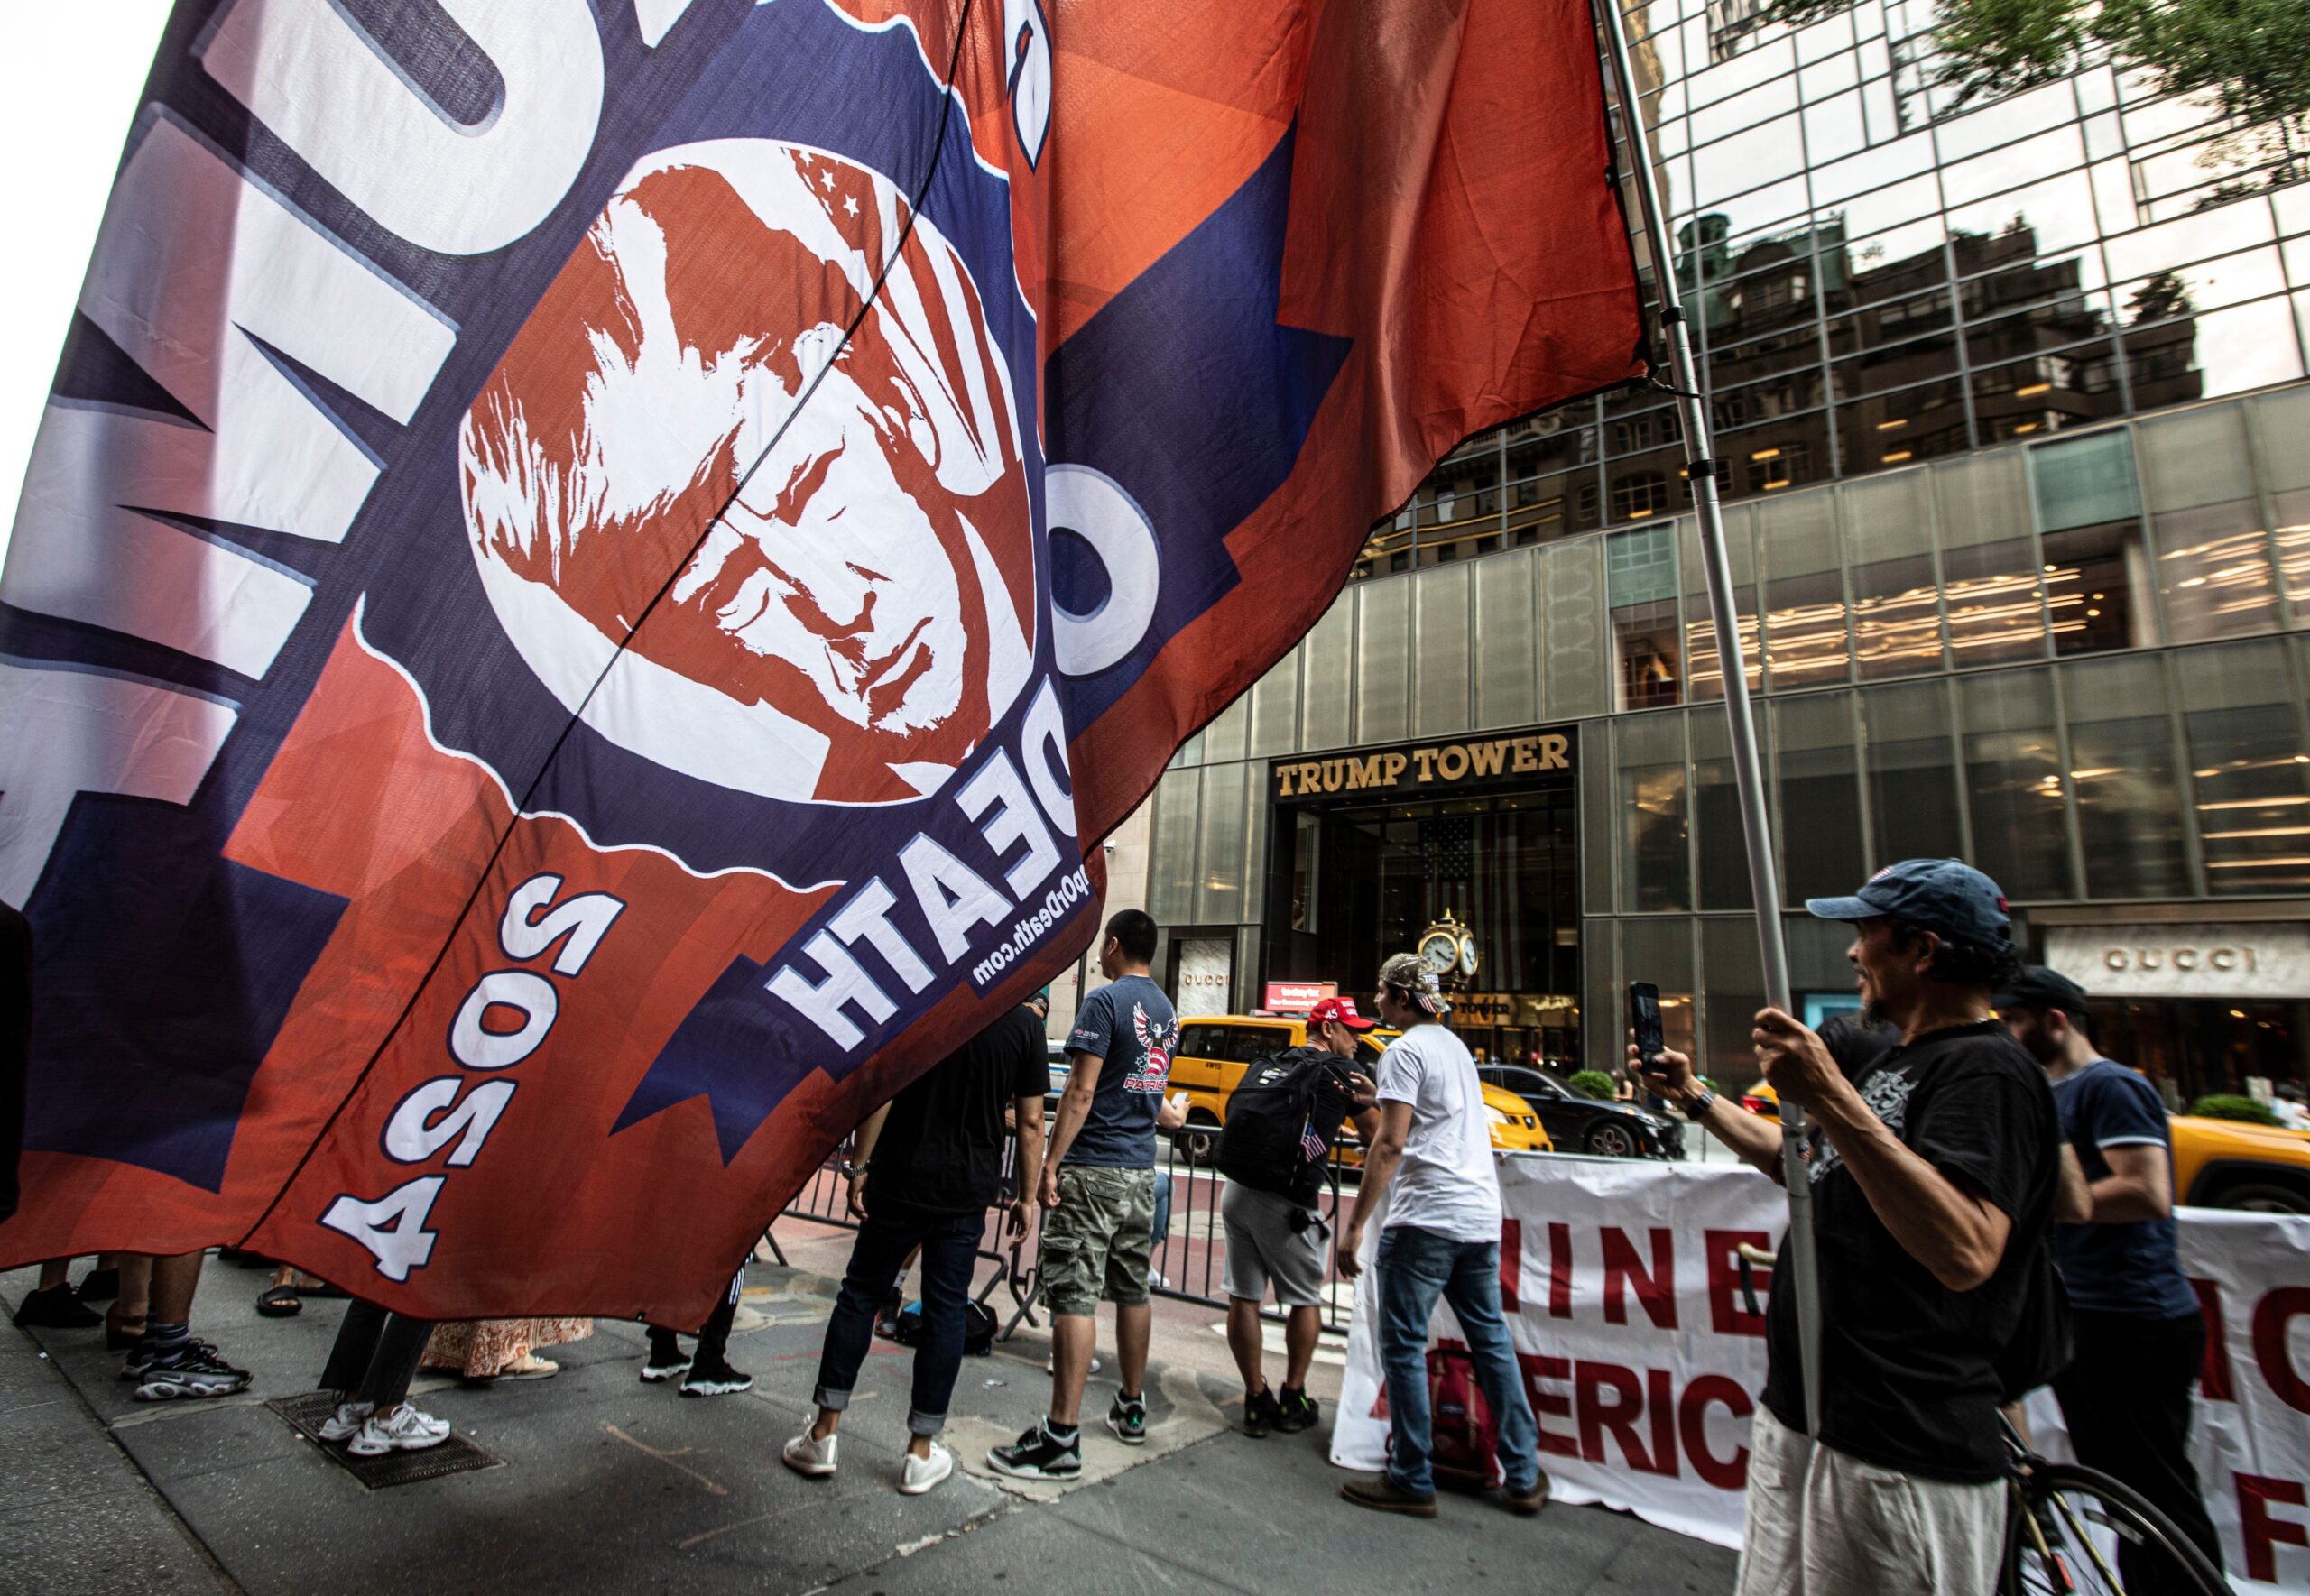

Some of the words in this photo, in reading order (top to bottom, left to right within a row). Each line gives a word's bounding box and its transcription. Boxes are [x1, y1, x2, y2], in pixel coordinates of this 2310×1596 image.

[1276, 752, 1408, 797] TRUMP
[1414, 733, 1570, 782] TOWER
[2102, 946, 2258, 973] GUCCI
[1185, 973, 1230, 986] GUCCI
[1423, 974, 1440, 985] TRU
[1325, 1008, 1338, 1019] 45
[1459, 1001, 1511, 1016] TOWER
